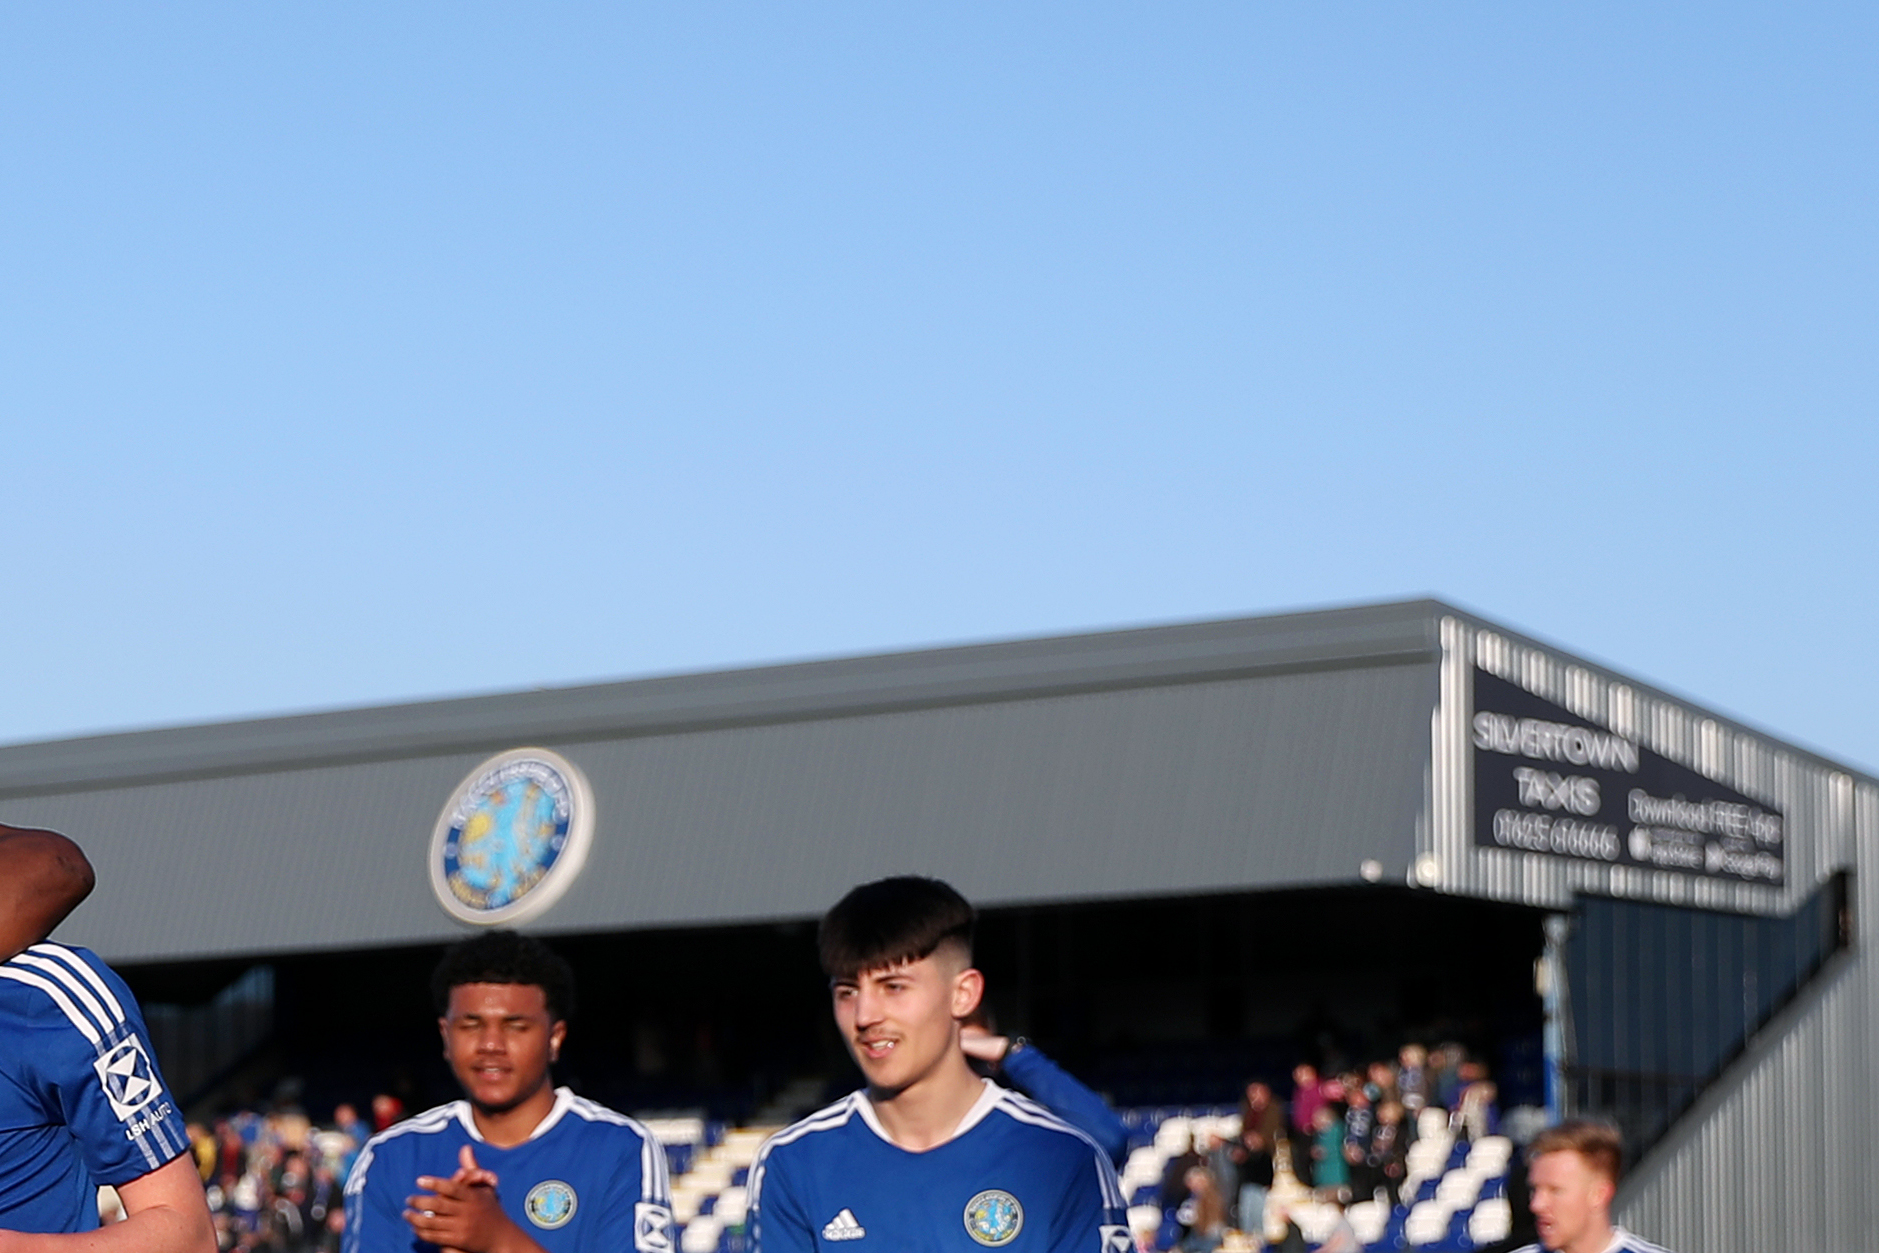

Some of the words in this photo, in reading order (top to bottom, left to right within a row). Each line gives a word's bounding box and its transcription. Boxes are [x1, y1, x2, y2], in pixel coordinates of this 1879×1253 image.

[1473, 711, 1639, 774] SILVERTOWN
[1512, 766, 1601, 816] TAXIS
[125, 1119, 150, 1141] LSH
[149, 1101, 172, 1126] AUTO
